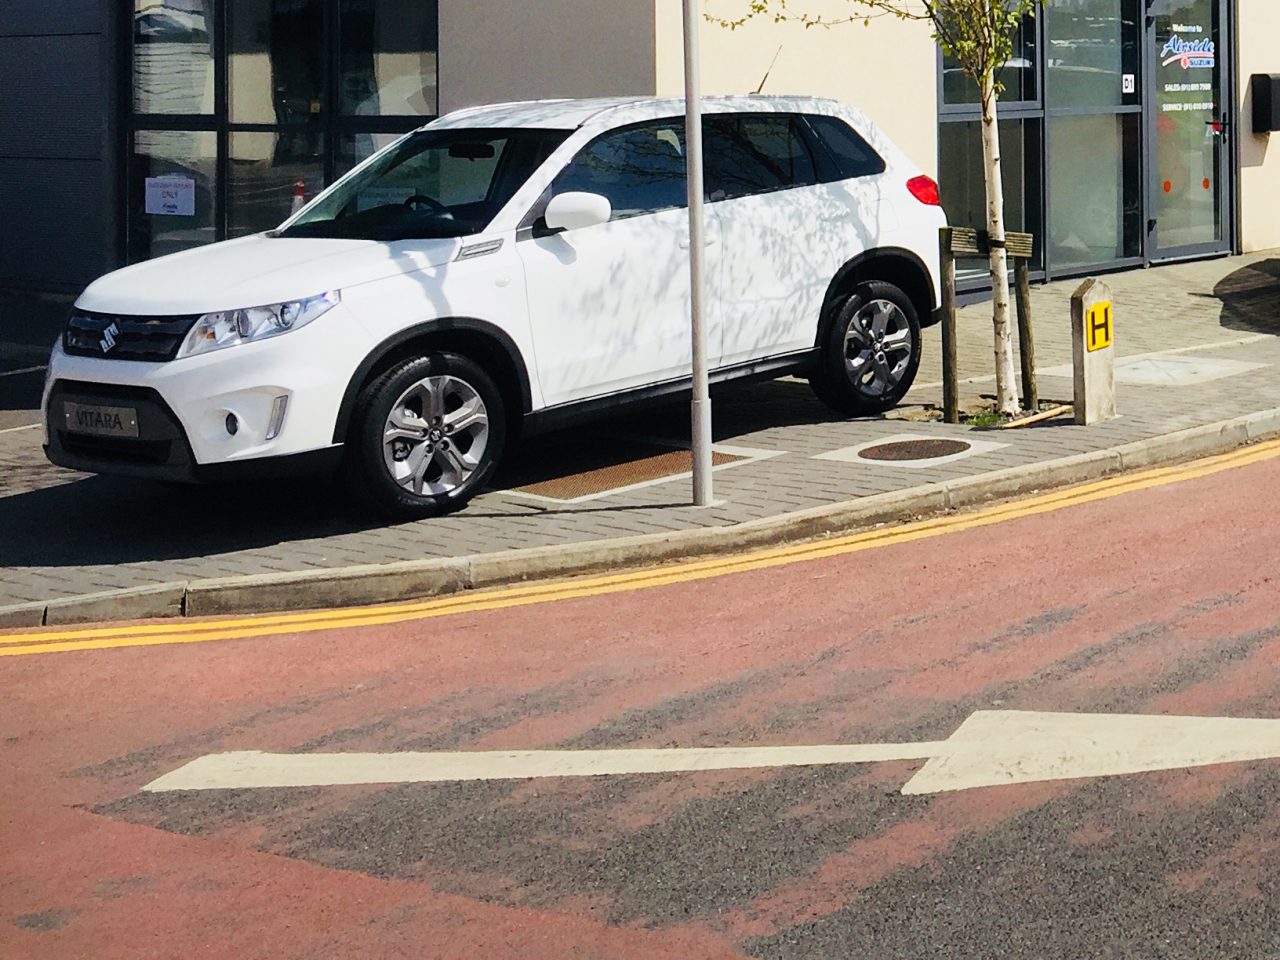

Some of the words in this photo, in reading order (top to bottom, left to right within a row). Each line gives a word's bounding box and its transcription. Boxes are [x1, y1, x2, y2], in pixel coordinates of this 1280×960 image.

[1160, 34, 1215, 58] Airside
[1189, 58, 1214, 67] SUZUKI
[1124, 77, 1133, 90] D1
[1091, 307, 1109, 347] H
[76, 407, 124, 431] VITARA
